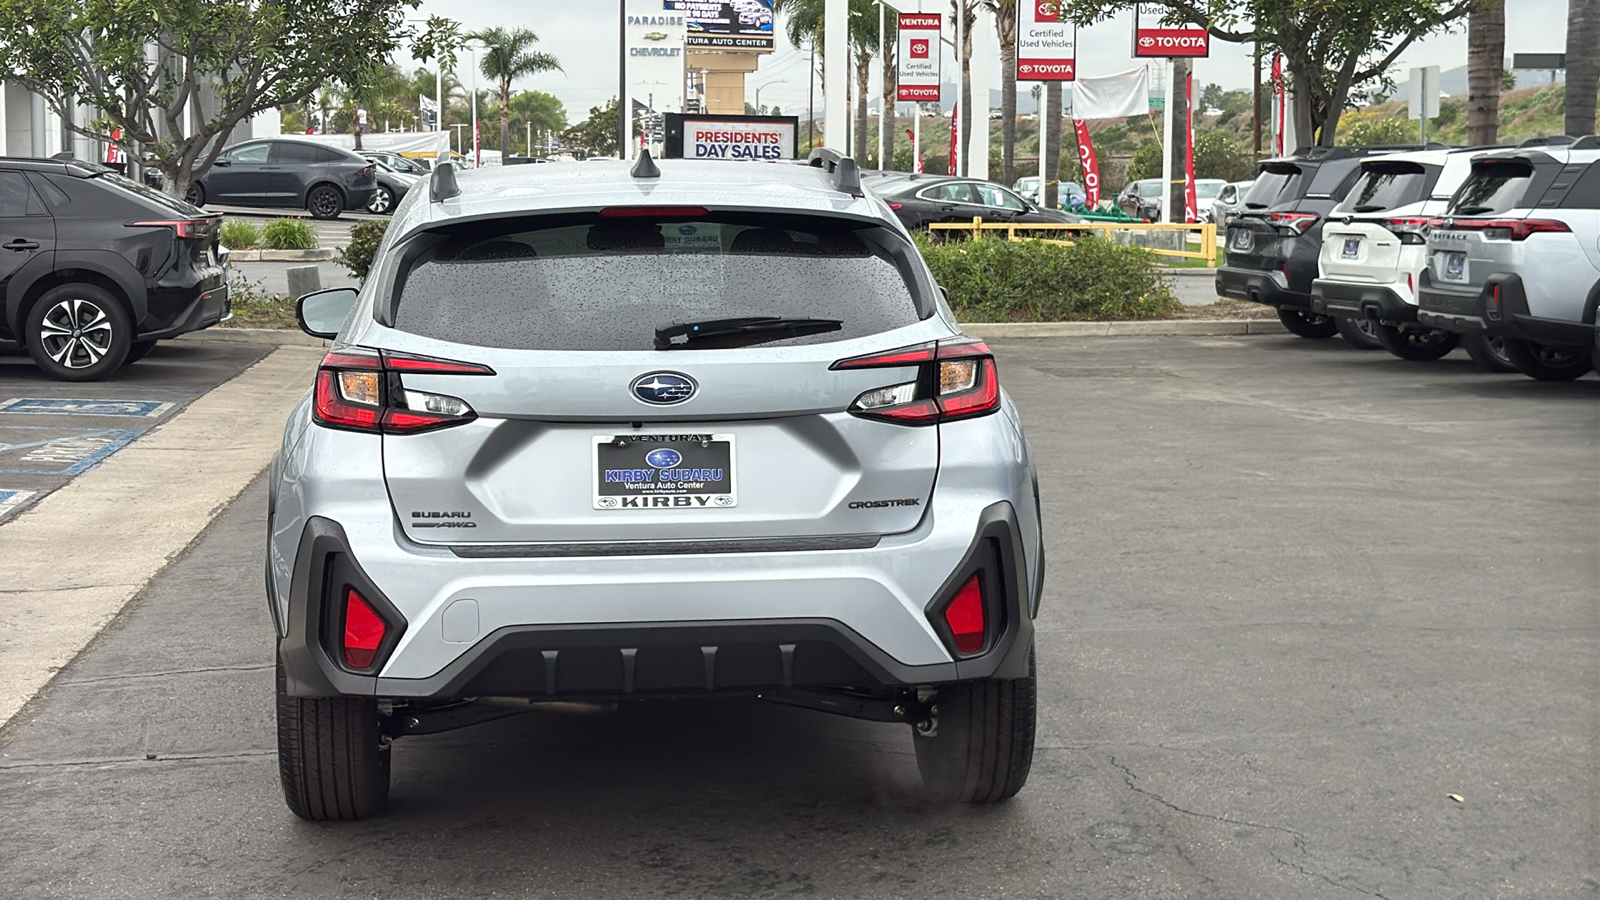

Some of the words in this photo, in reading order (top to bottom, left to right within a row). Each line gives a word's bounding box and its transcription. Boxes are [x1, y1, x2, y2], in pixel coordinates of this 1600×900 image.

[1139, 5, 1165, 15] Used
[628, 16, 683, 26] PARADISE
[900, 18, 940, 26] VENTURA
[1029, 29, 1064, 38] Certified
[687, 37, 708, 45] TURA
[1020, 40, 1040, 48] Used
[1041, 40, 1073, 48] Vehicles
[1155, 36, 1206, 48] TOYOTA
[630, 47, 681, 57] CHEVROLET
[1032, 64, 1073, 73] TOYOTA
[909, 89, 939, 97] TOYOTA
[695, 143, 729, 158] DAY
[731, 144, 781, 159] SALES
[629, 434, 701, 442] VENTURA
[605, 469, 655, 483] KIRBY
[659, 469, 723, 481] SUBARU
[624, 482, 655, 490] Ventura
[656, 481, 676, 490] Auto
[677, 481, 704, 489] Center
[621, 496, 711, 507] KIRBY
[848, 498, 920, 510] CROSSTREK
[411, 511, 471, 519] SUBARU
